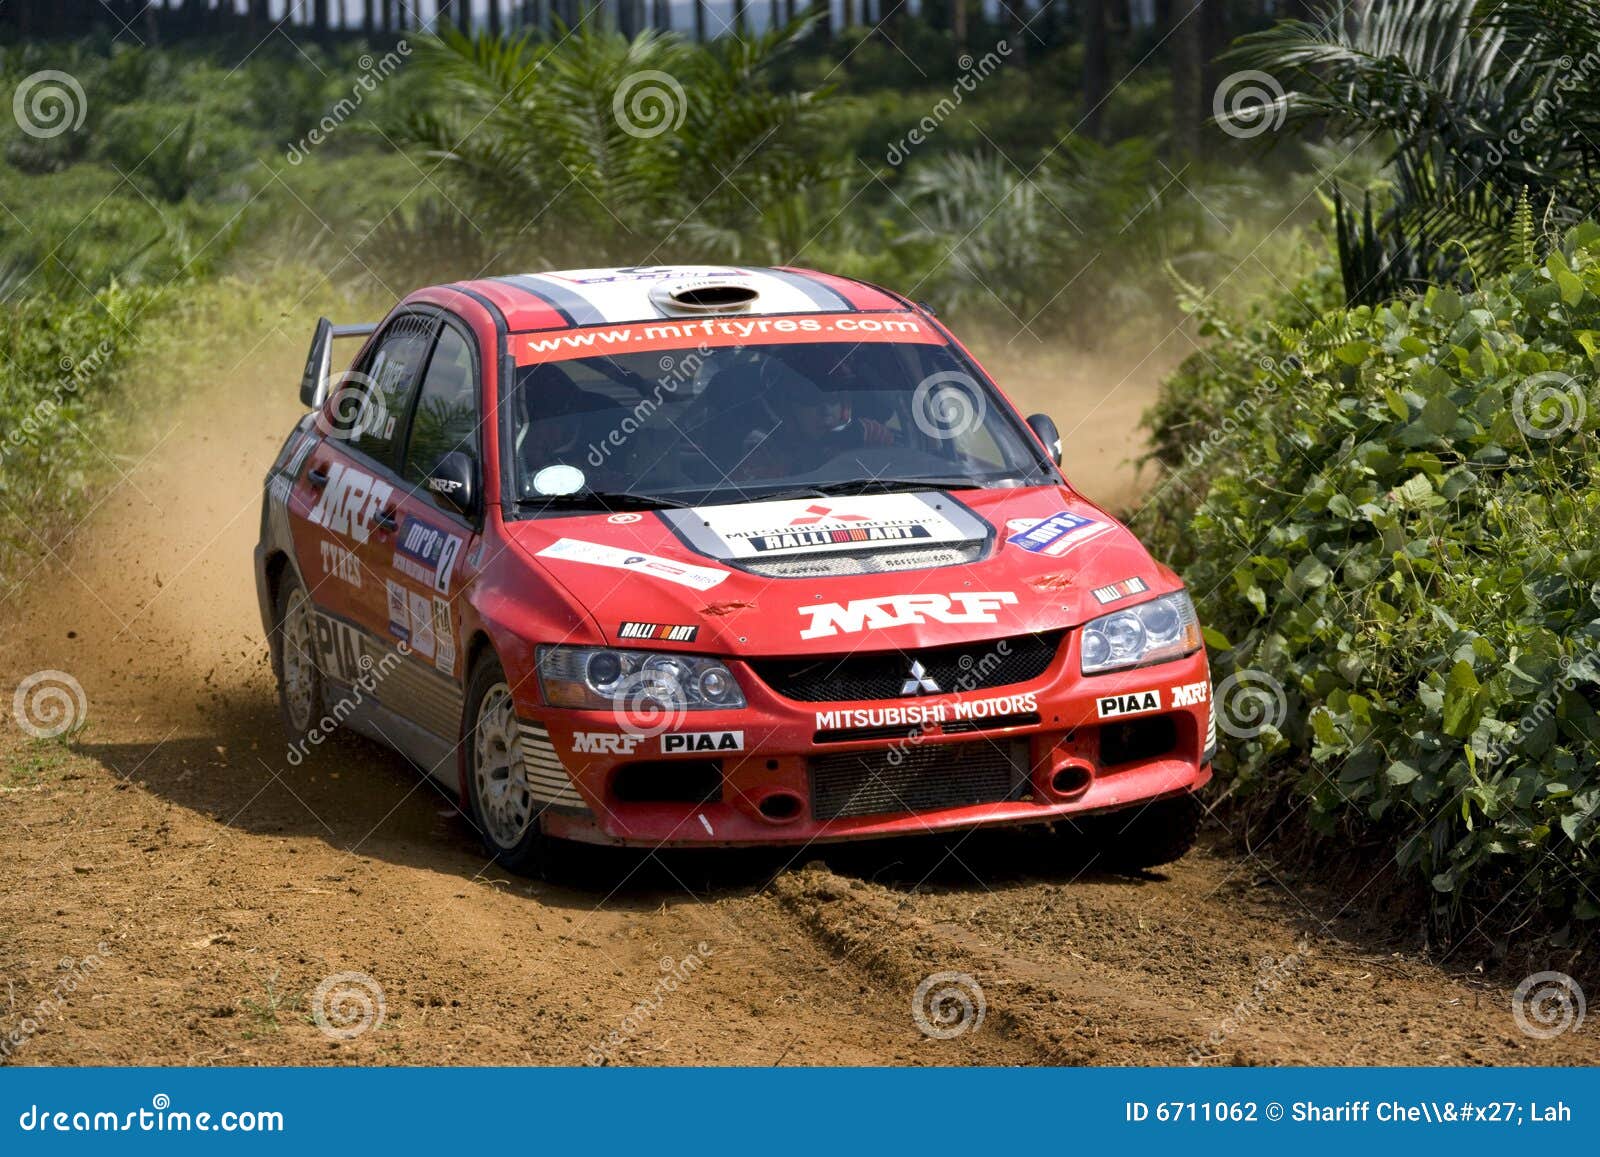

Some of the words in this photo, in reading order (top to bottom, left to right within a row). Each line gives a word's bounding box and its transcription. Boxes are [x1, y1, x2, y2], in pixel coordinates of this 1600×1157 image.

[528, 316, 920, 353] www.mrftyres.com
[308, 462, 394, 544] MRF
[320, 540, 361, 588] TYRES
[438, 540, 456, 590] 2
[797, 591, 1018, 640] MRF
[815, 704, 945, 731] MITSUBISHI
[953, 693, 1038, 720] MOTORS
[1100, 692, 1158, 716] PIAA
[1171, 681, 1207, 708] MRF
[572, 731, 645, 755] MRF
[664, 732, 739, 753] PIAA
